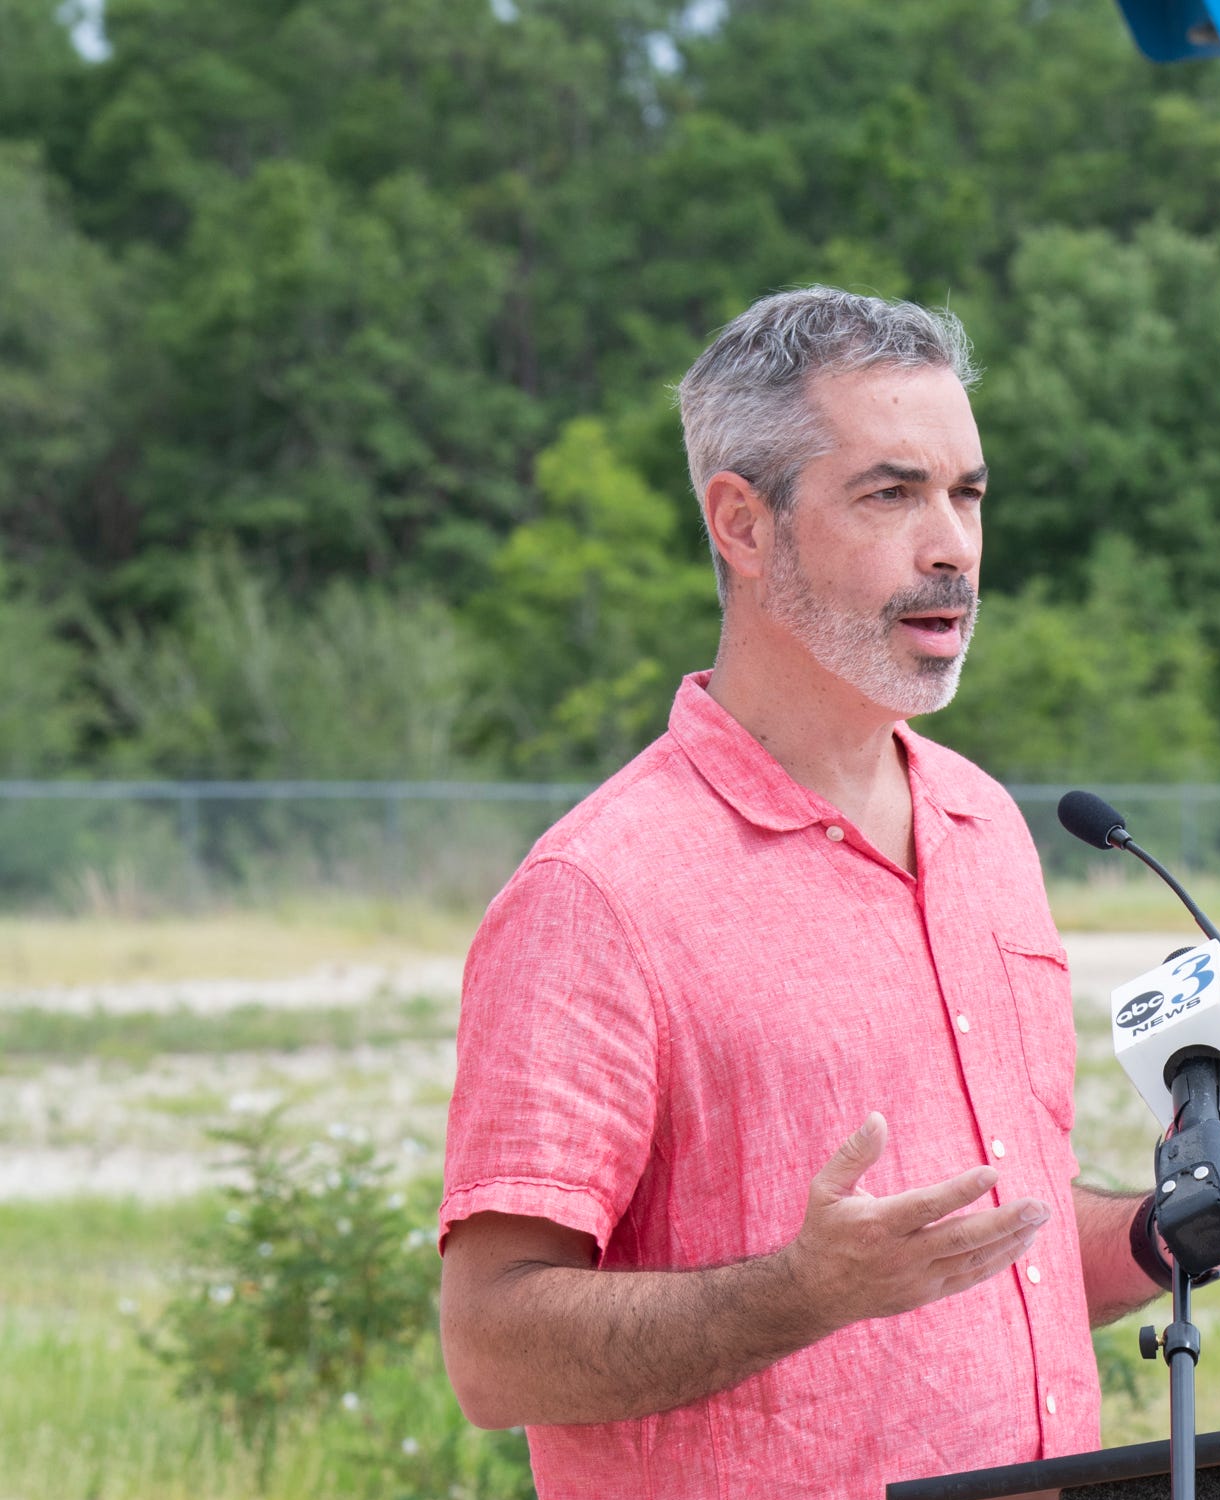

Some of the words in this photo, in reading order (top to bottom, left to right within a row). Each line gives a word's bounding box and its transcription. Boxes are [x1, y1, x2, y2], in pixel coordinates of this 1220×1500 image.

[1116, 993, 1164, 1025] abc
[1171, 954, 1215, 1004] 3
[1133, 997, 1201, 1037] NEWS
